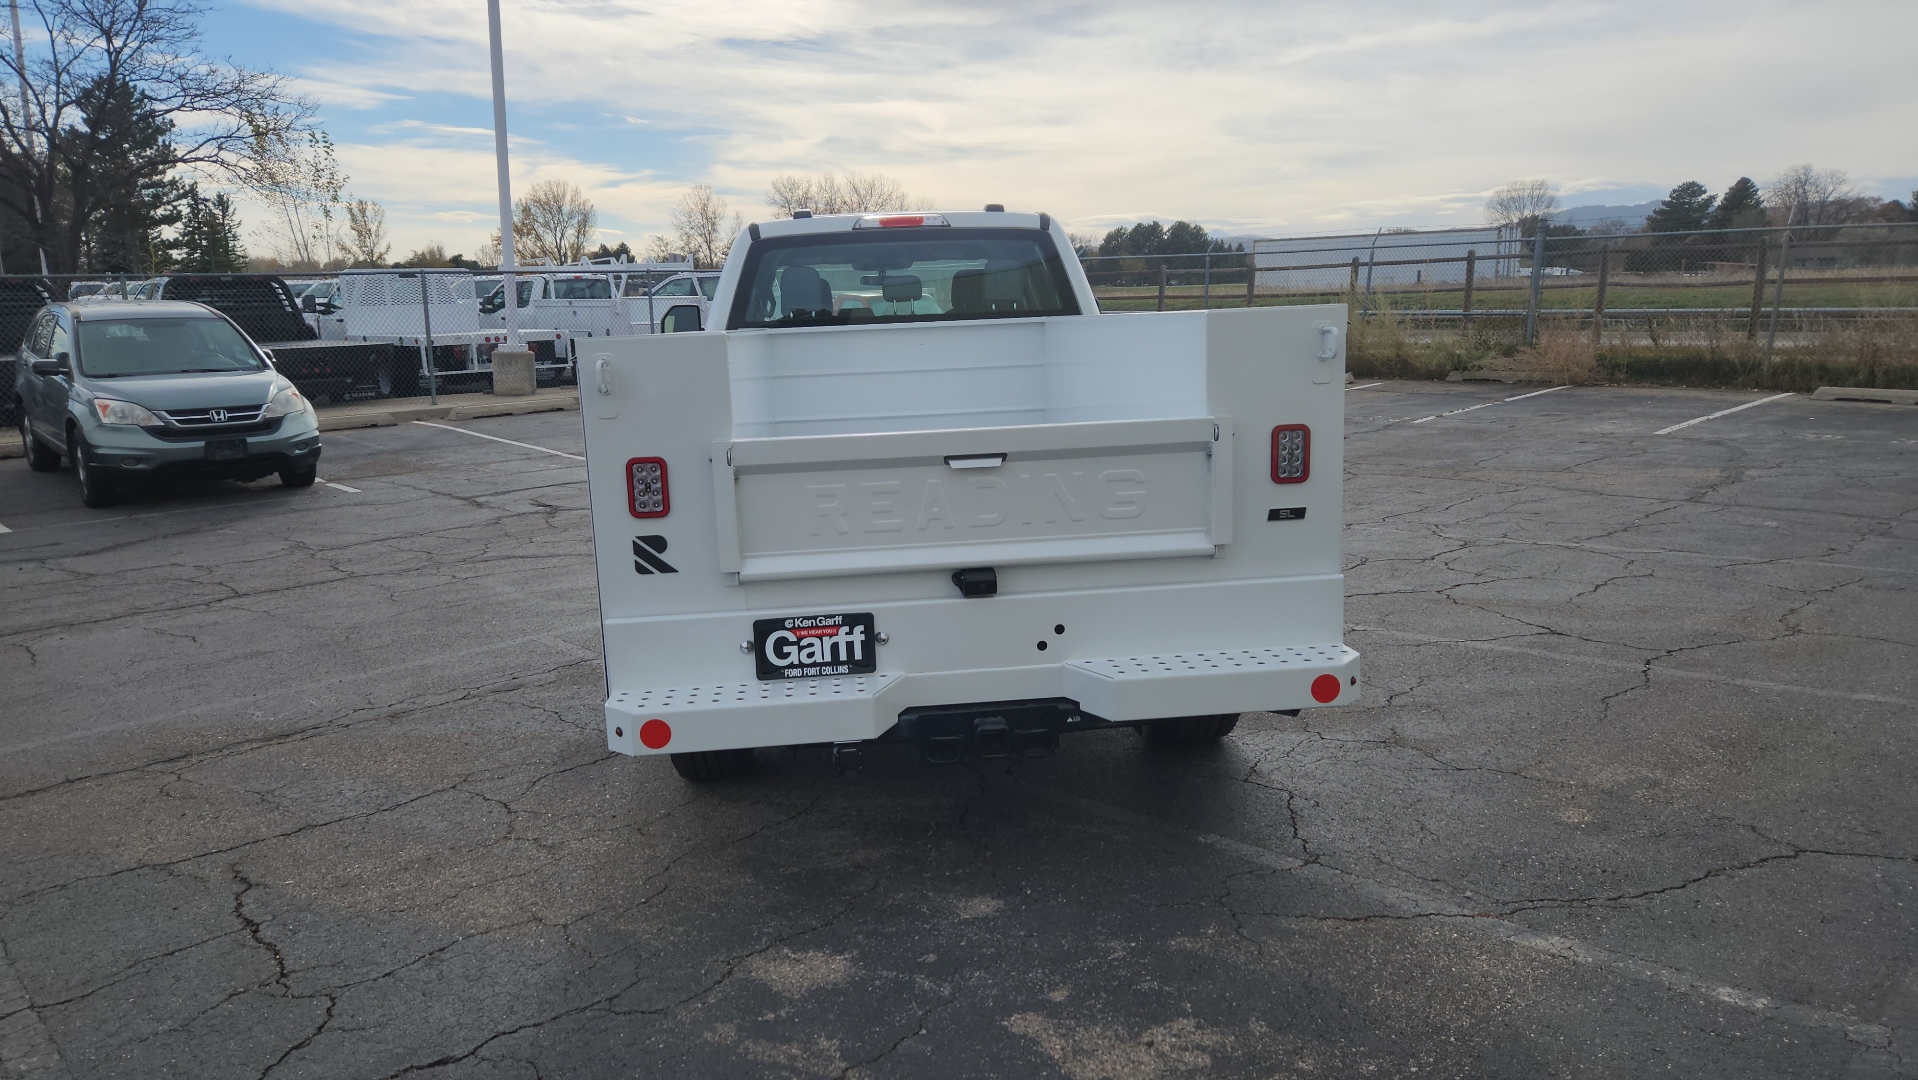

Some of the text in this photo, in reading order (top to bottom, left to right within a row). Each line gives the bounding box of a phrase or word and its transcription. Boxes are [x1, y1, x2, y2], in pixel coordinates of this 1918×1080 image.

[805, 469, 1147, 537] READING
[795, 615, 843, 628] Ken Garff
[765, 624, 865, 667] Garff
[784, 664, 849, 678] FORD FORT COLLINS
